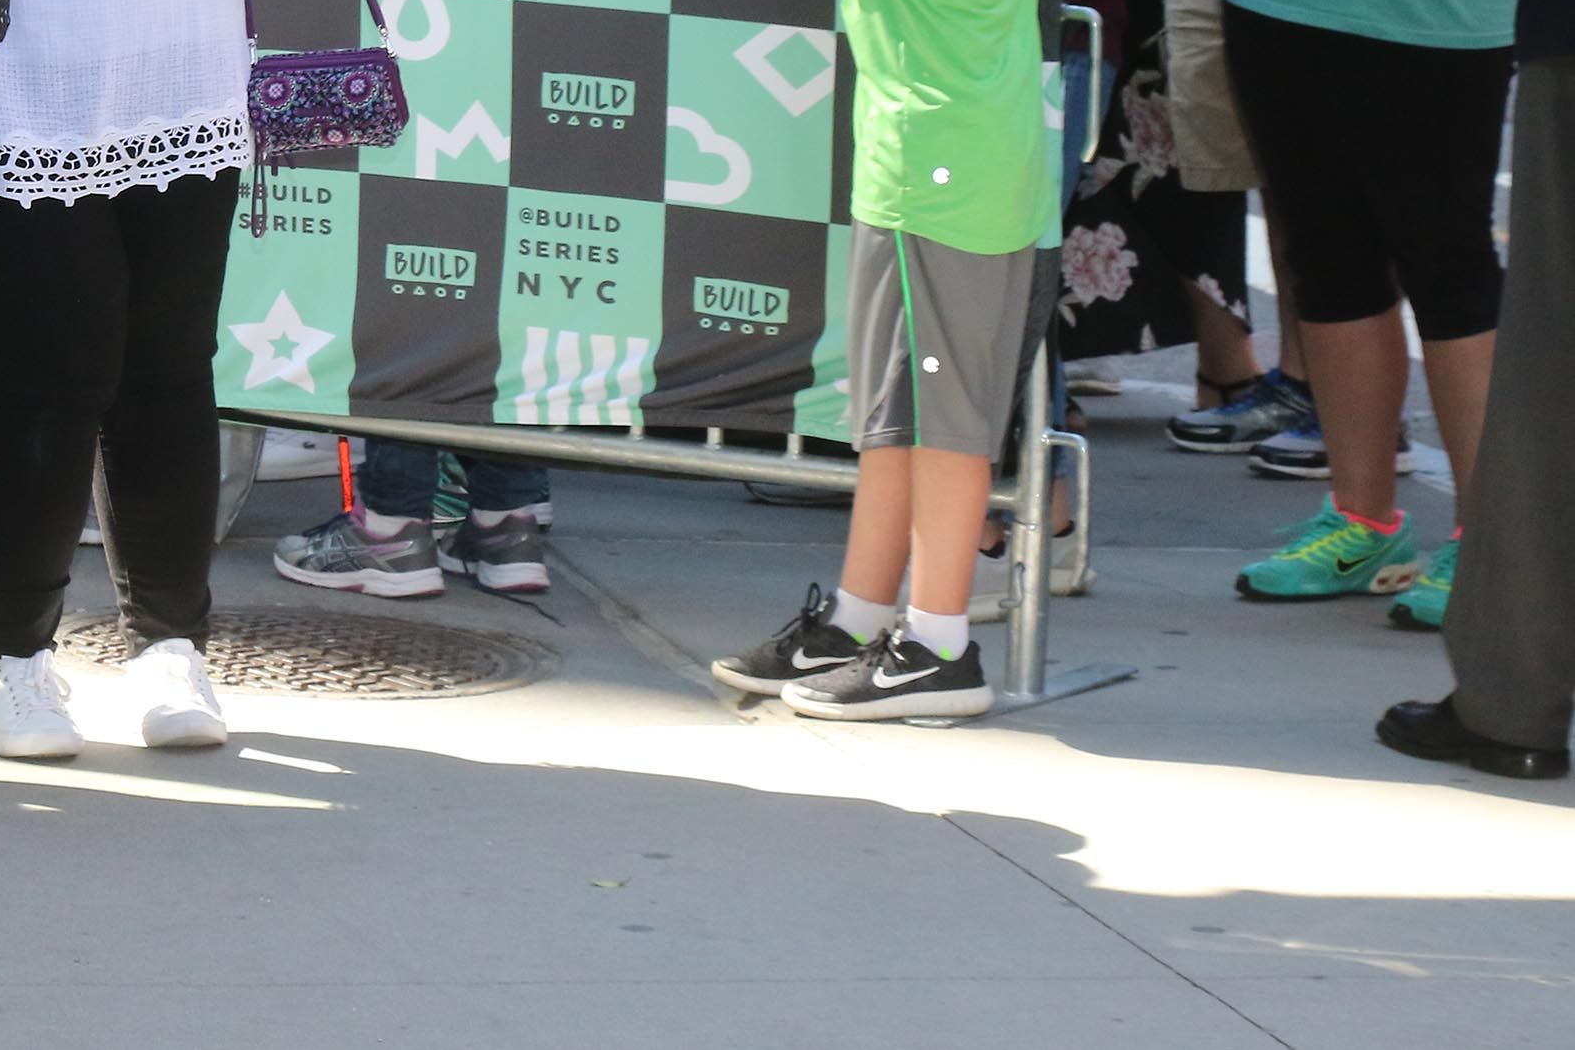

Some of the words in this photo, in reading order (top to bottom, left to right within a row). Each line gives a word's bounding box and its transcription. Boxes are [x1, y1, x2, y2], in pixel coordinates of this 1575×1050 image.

[550, 80, 628, 110] BUILD
[238, 183, 332, 204] #BUILD
[239, 213, 333, 236] SERIES
[519, 207, 621, 233] @BUILD
[394, 251, 470, 280] BUILD
[518, 239, 619, 265] SERIES
[517, 271, 617, 304] NYC
[704, 284, 781, 317] BUILD
